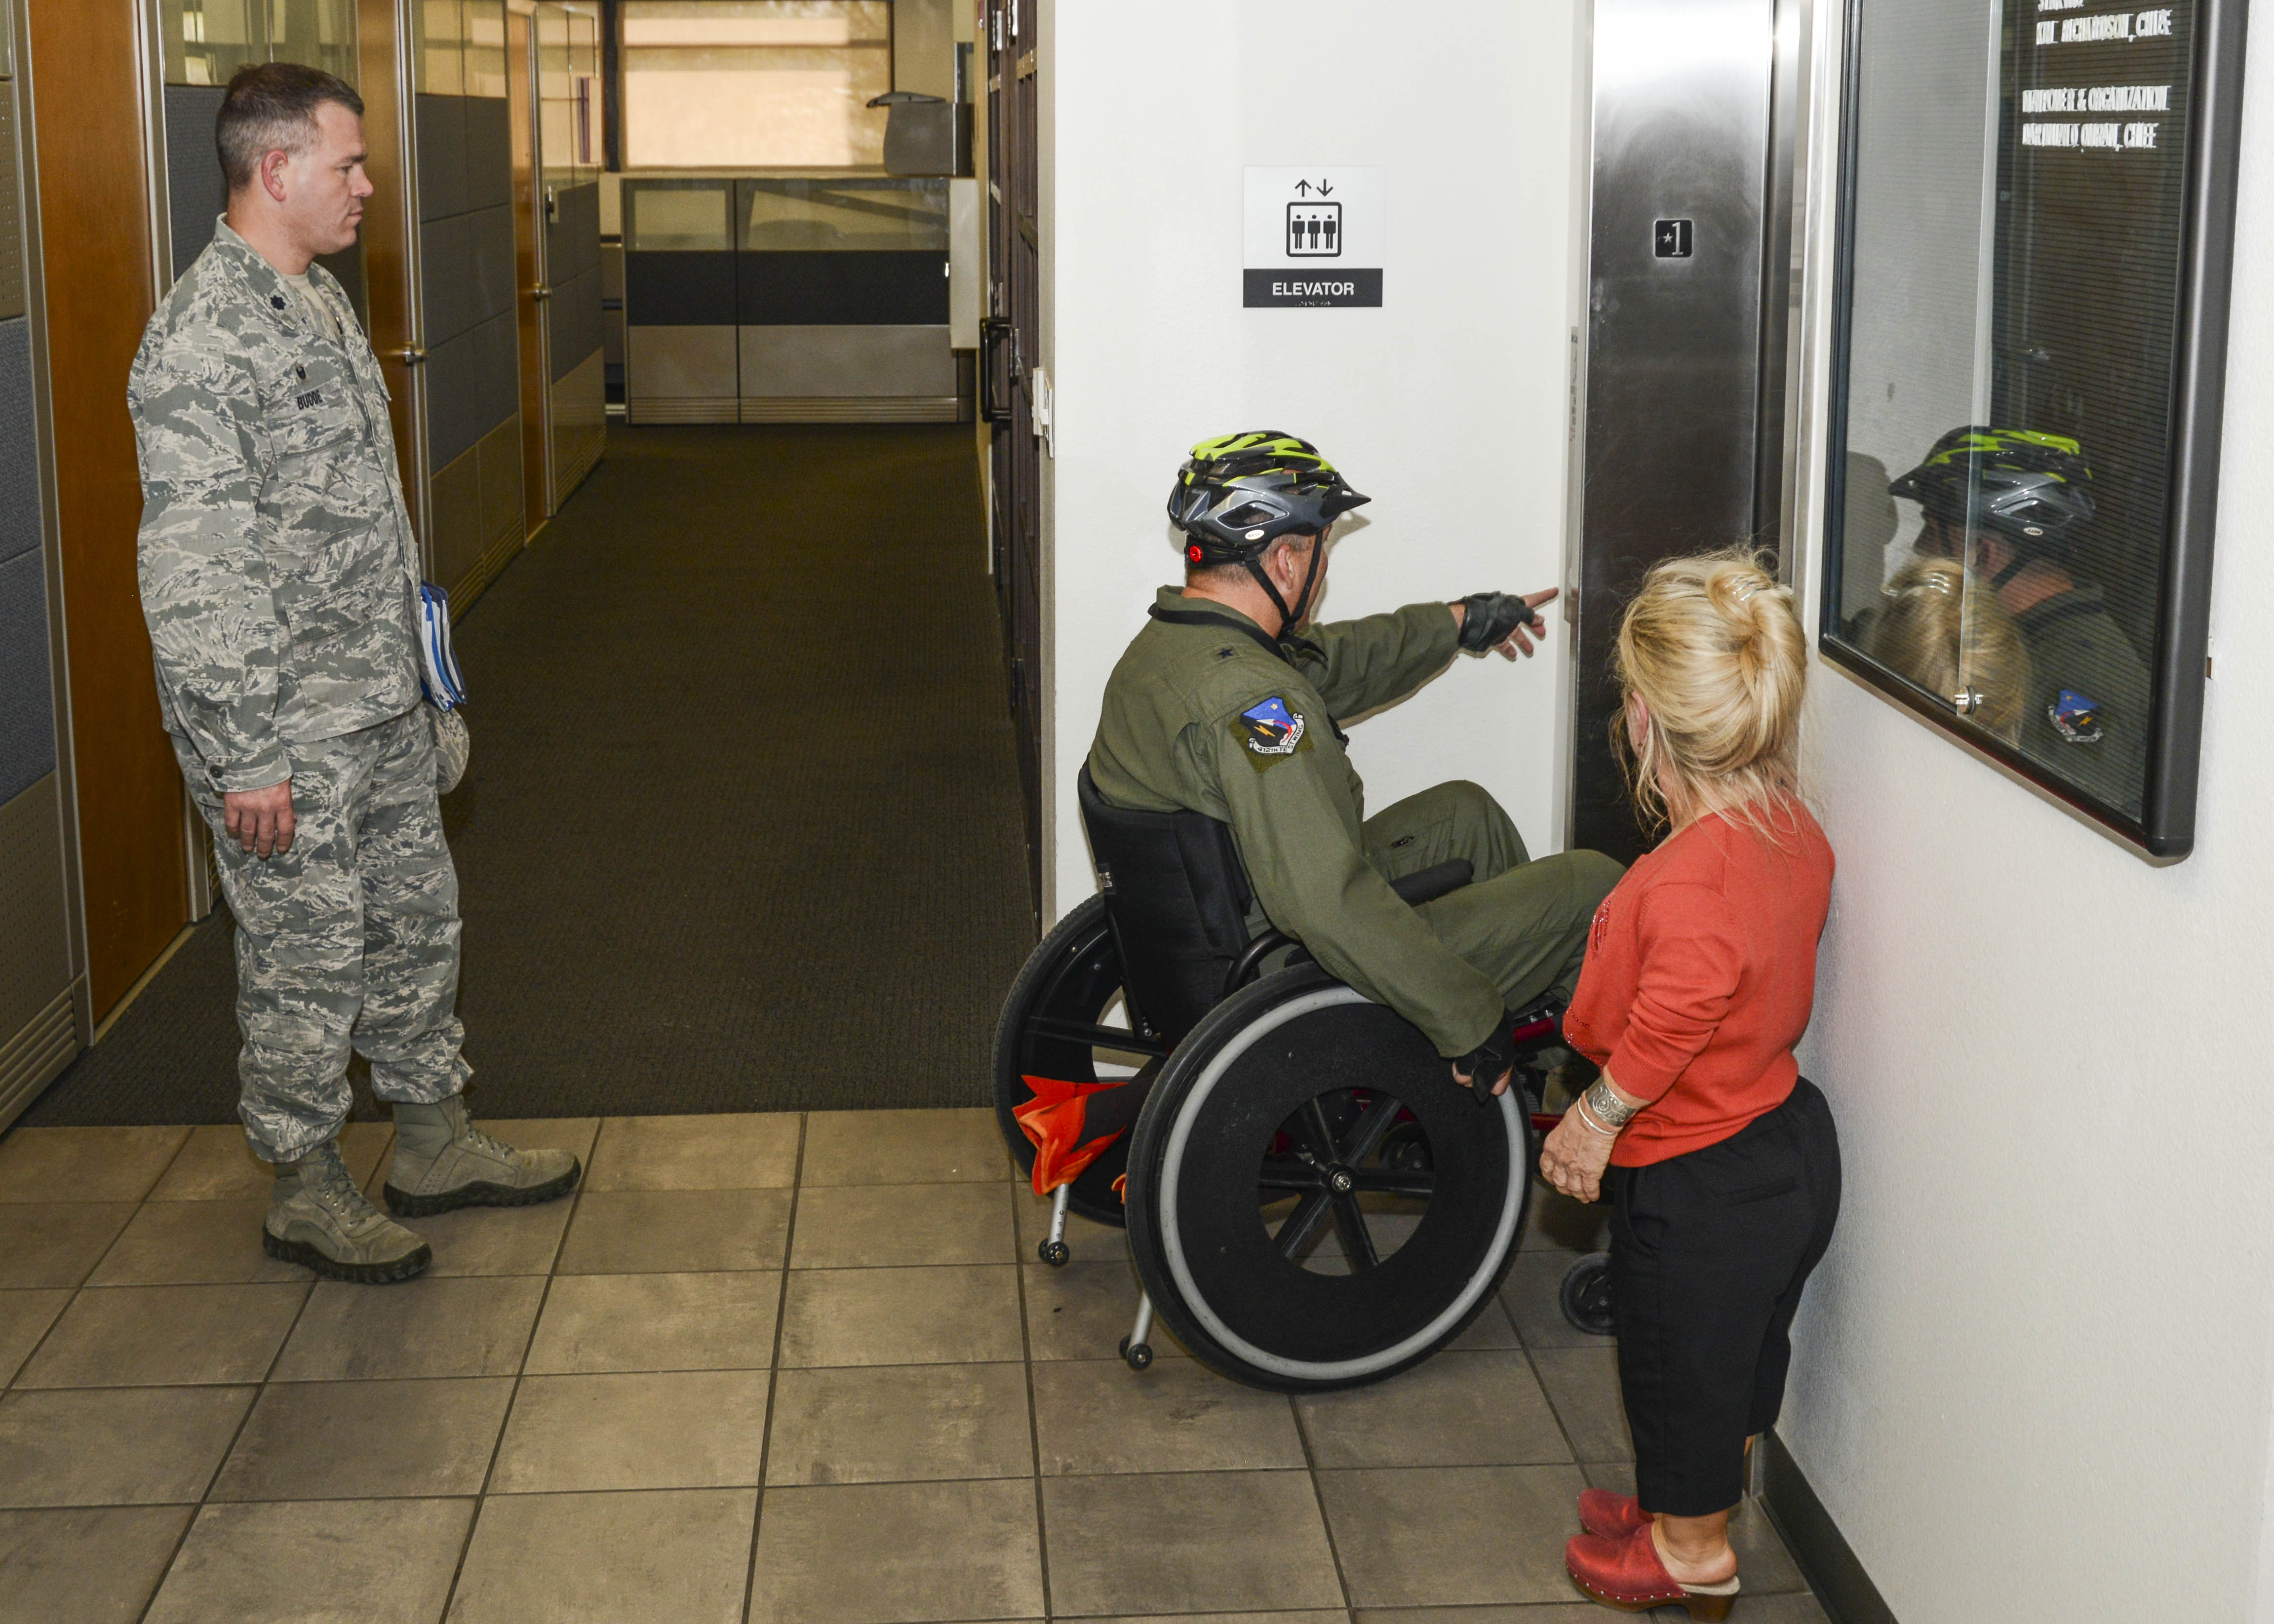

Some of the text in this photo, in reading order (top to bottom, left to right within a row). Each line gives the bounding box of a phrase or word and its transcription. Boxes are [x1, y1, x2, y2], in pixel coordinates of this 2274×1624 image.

[2077, 88, 2087, 112] &
[2088, 85, 2171, 111] ORGANIZATION
[1272, 282, 1355, 296] ELEVATOR
[297, 389, 323, 410] BUDDE
[1293, 725, 1303, 741] WING
